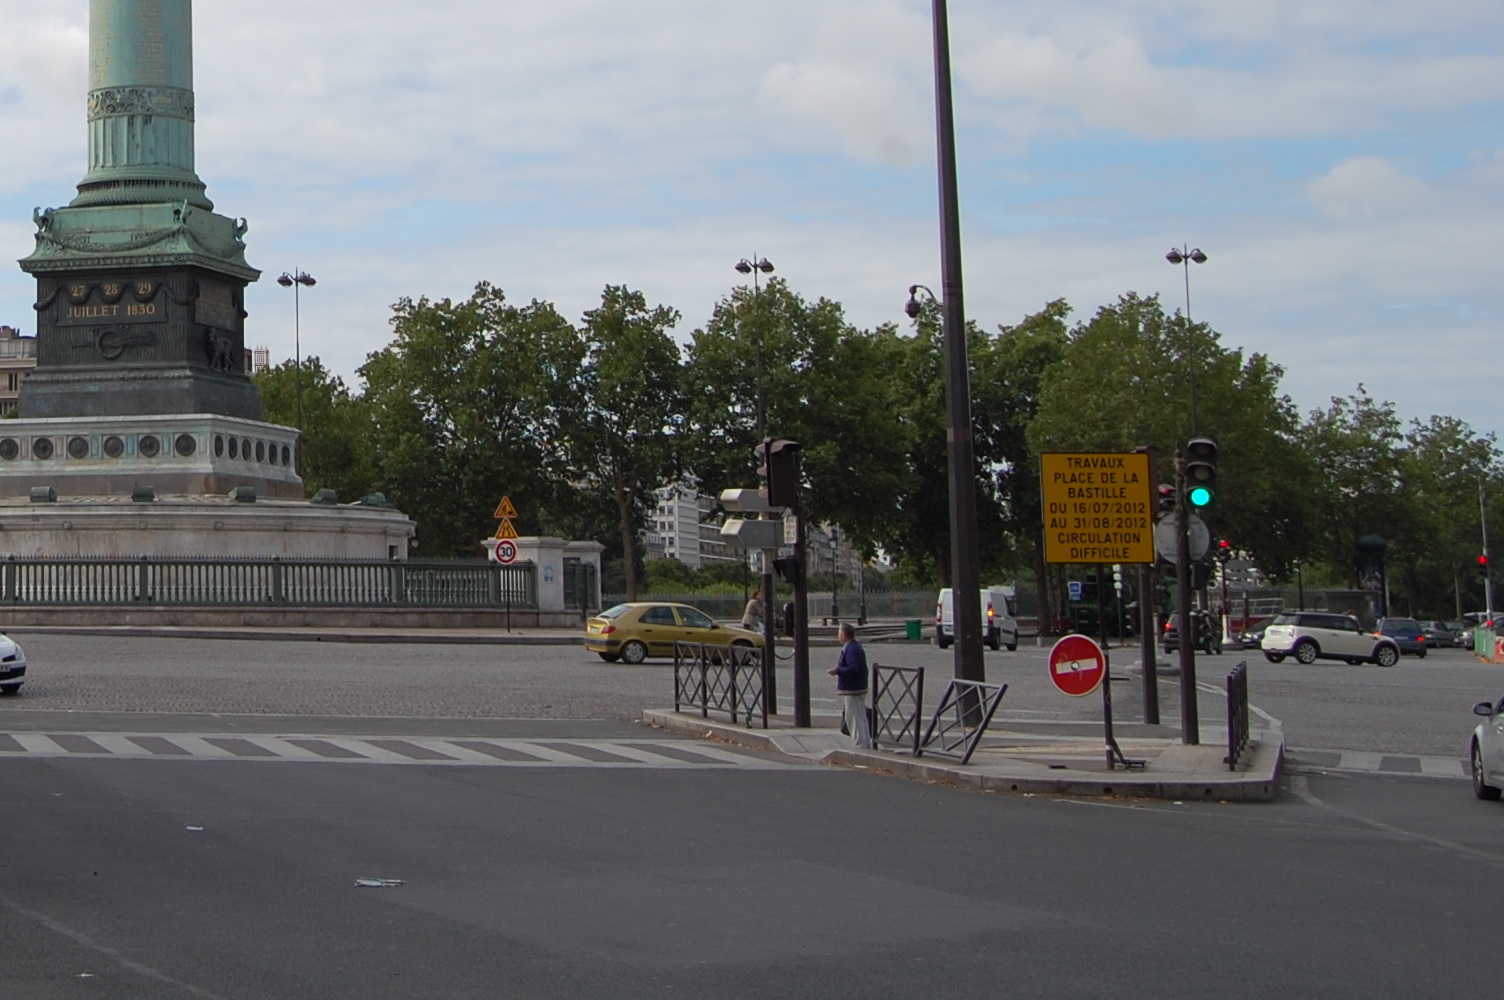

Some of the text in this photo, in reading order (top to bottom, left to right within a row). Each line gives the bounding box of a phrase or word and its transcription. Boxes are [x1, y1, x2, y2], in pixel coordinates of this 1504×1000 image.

[71, 283, 151, 297] 27 28 29
[66, 303, 156, 318] JUILLET 1830
[1066, 457, 1124, 468] TRAVAUX
[1054, 472, 1138, 483] PLACE DE LA
[1068, 487, 1127, 498] BASTILLE
[1050, 502, 1146, 513] DU 16/07/2012
[1050, 517, 1147, 528] AU 31/08/2012
[1058, 532, 1141, 543] CIRCULATION
[499, 546, 513, 557] 30
[1070, 547, 1130, 558] DIFFICILE
